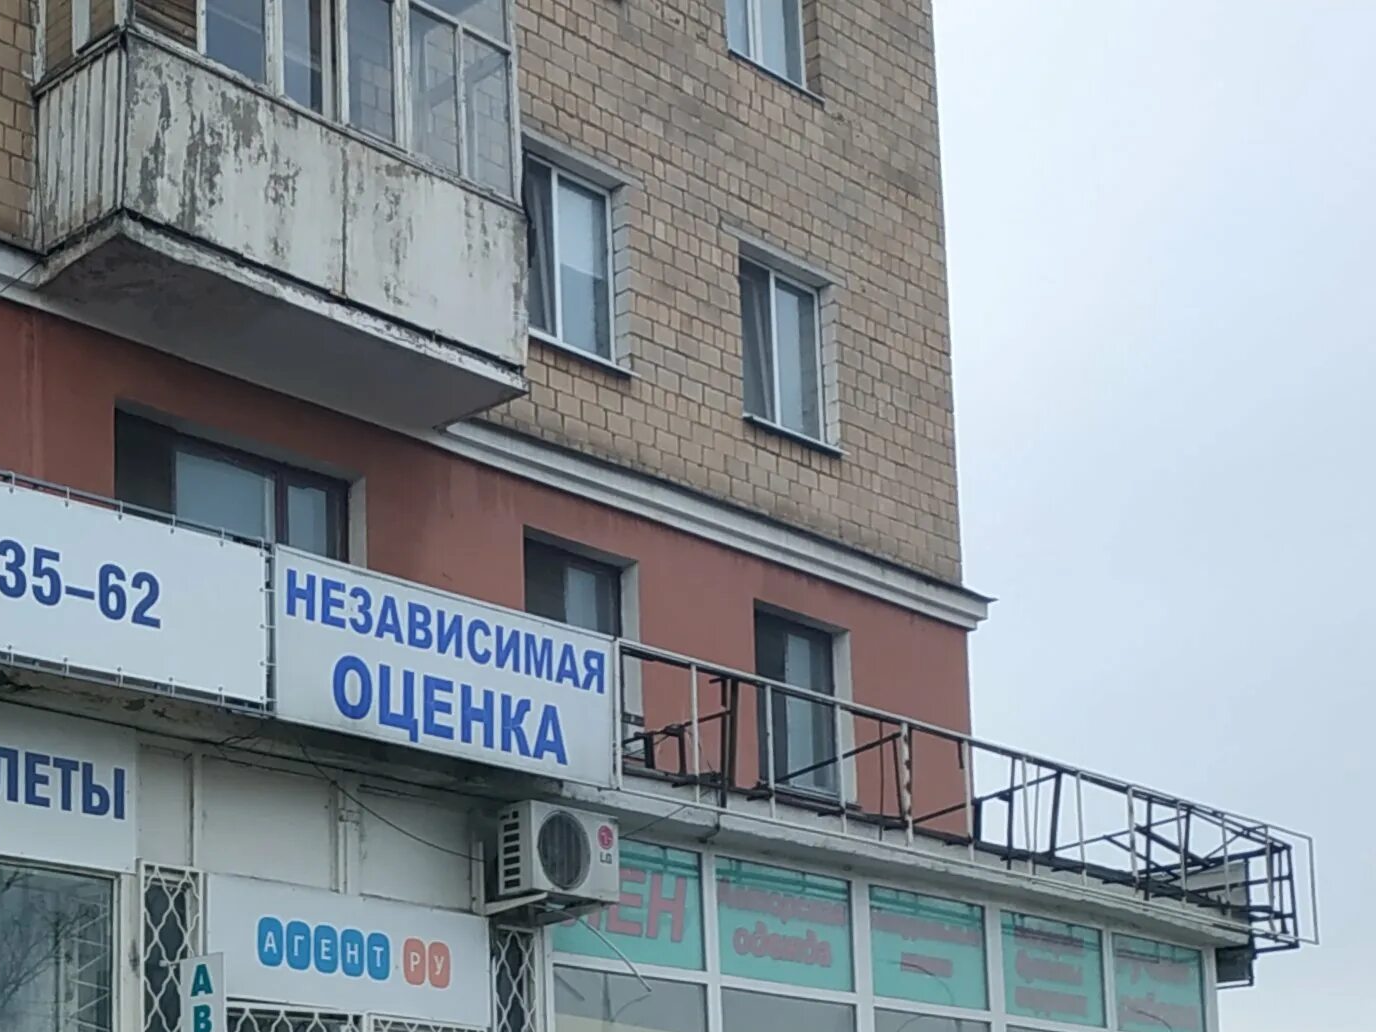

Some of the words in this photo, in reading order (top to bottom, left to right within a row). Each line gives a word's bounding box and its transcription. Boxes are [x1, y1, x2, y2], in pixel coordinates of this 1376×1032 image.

[285, 567, 606, 695] НЕЗАВИСИМАЯ
[332, 655, 568, 766] ОЦЕНКА
[560, 866, 688, 944] ЕН
